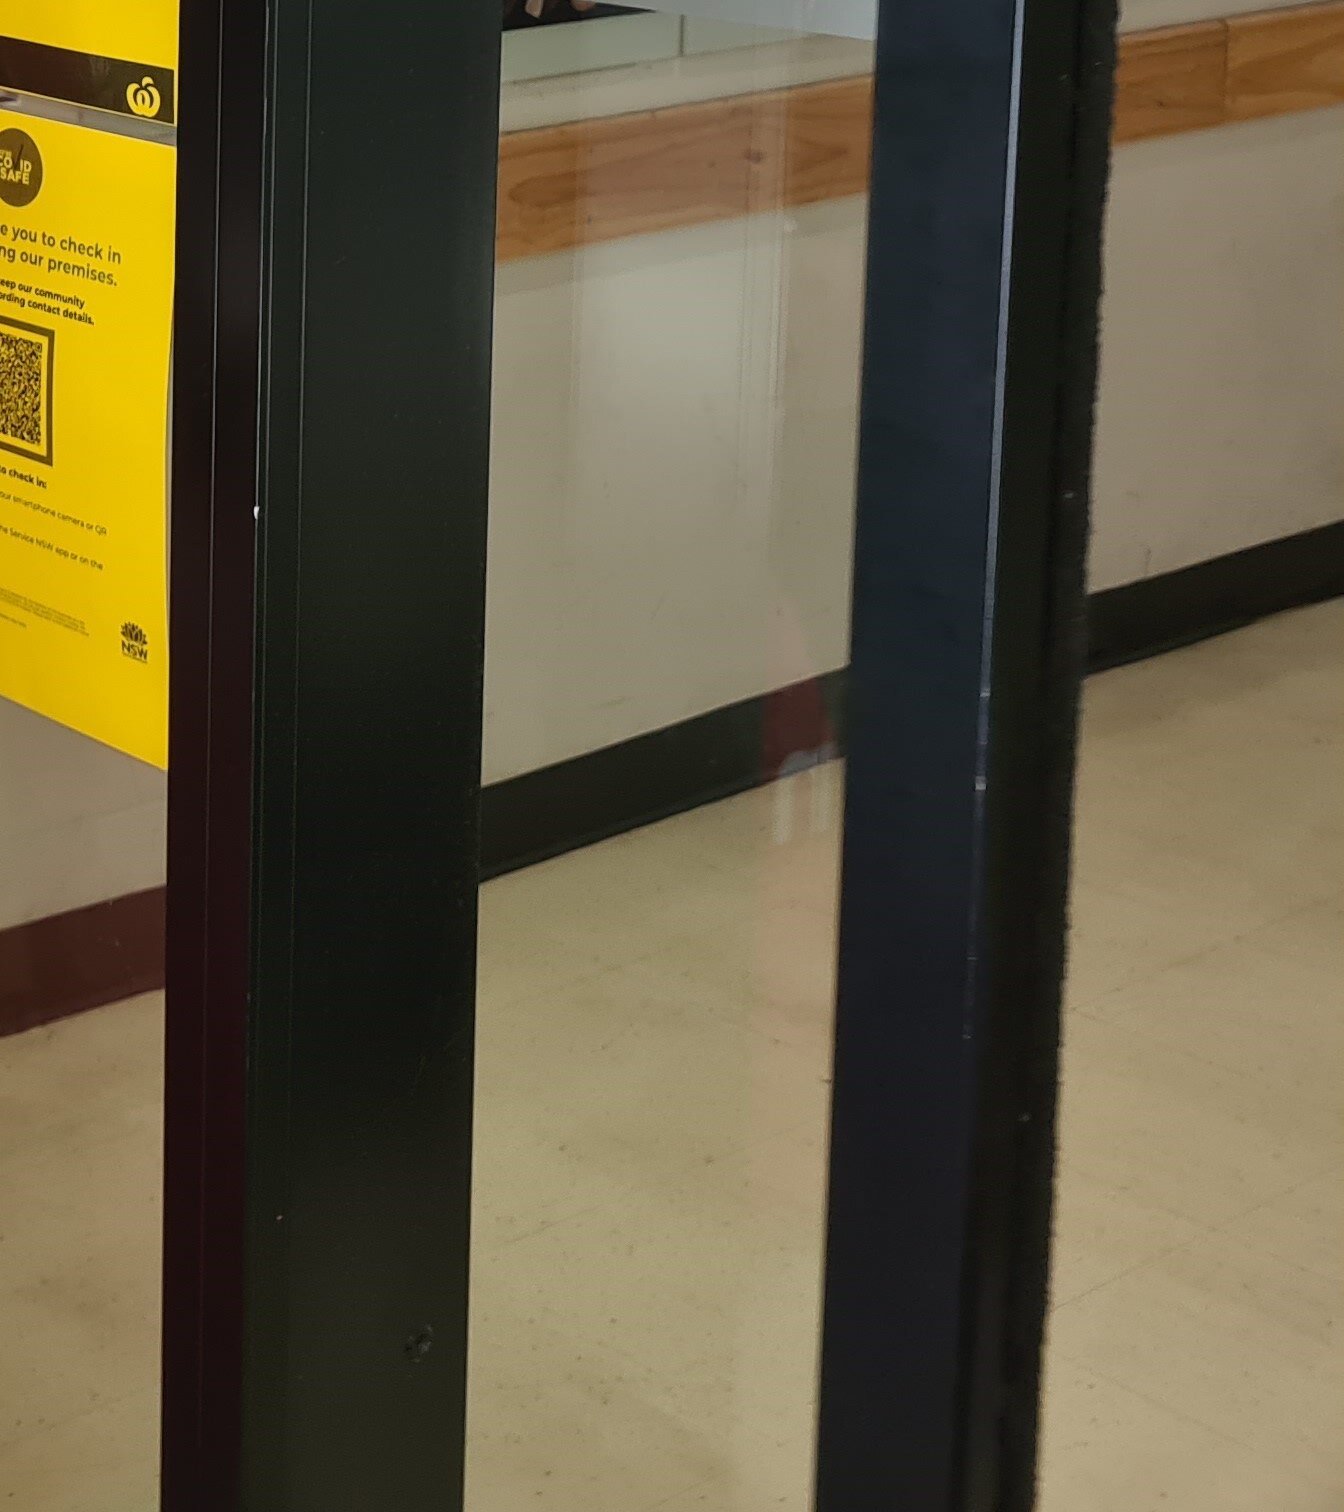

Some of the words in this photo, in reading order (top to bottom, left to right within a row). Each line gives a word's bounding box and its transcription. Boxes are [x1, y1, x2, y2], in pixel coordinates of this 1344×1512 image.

[0, 167, 30, 186] SAFE
[12, 226, 37, 243] you
[41, 231, 56, 247] to
[60, 236, 103, 260] check
[108, 245, 121, 265] in
[20, 251, 44, 267] our
[47, 257, 118, 287] premises.
[18, 281, 32, 293] our
[34, 286, 85, 310] community
[28, 298, 61, 316] contact
[8, 467, 35, 485] check
[121, 638, 149, 661] NSW
